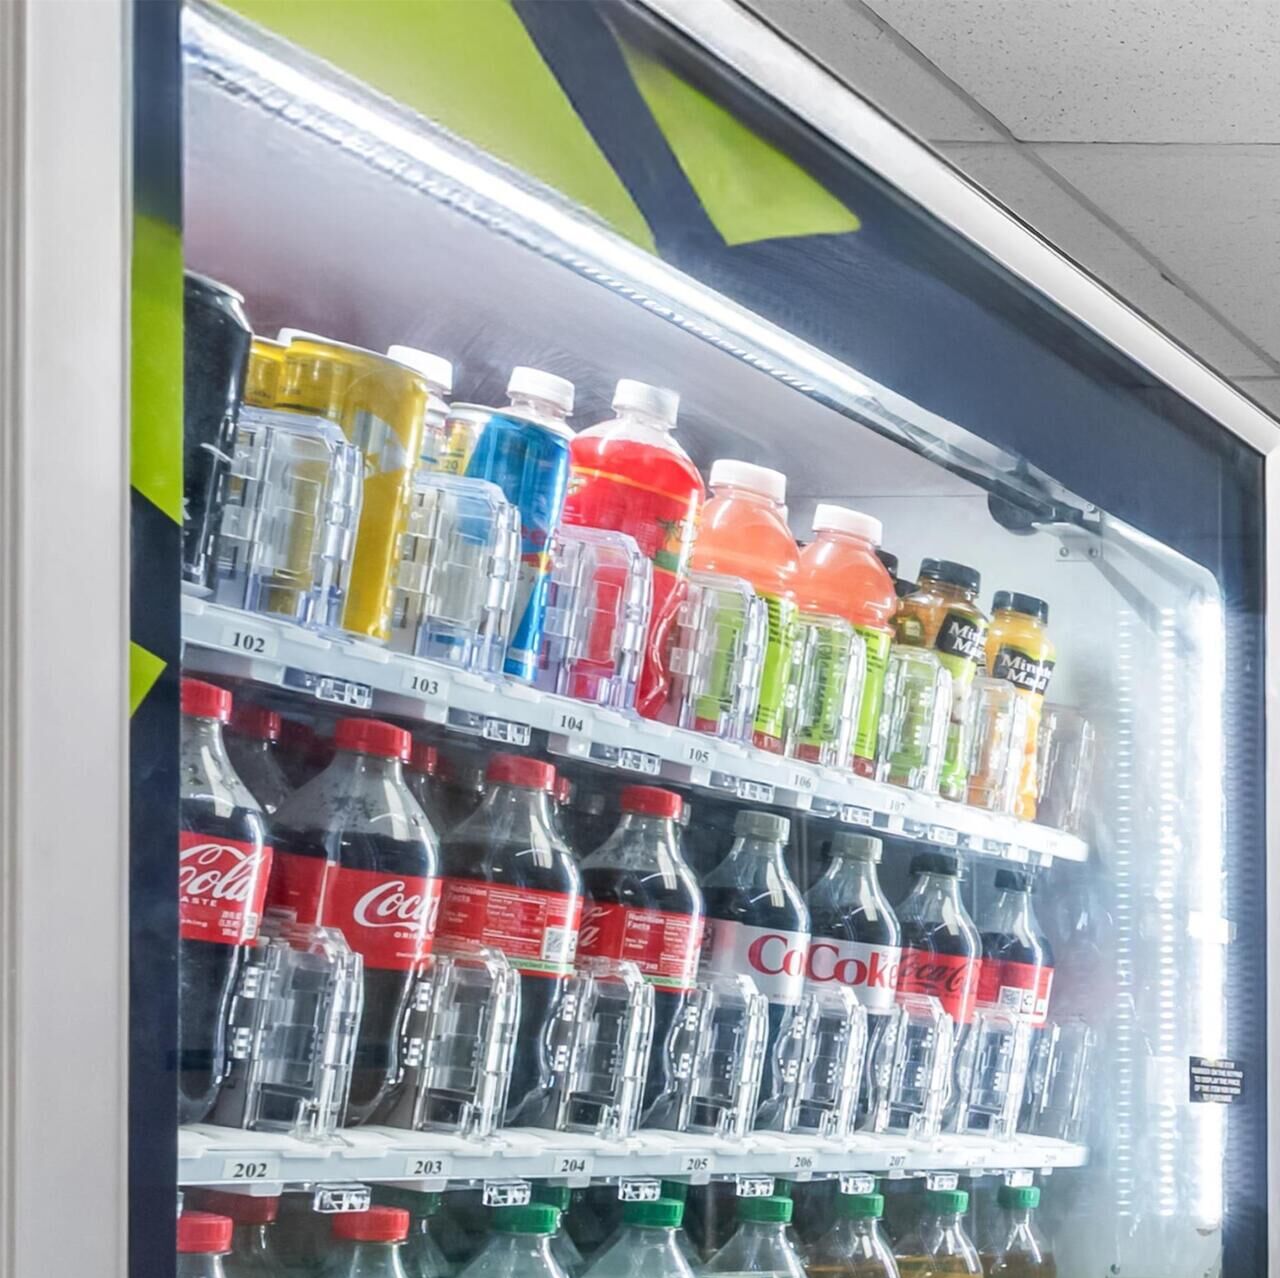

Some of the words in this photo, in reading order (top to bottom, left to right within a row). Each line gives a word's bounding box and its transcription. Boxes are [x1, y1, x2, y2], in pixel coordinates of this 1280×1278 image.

[232, 631, 265, 653] 102
[411, 675, 439, 695] 103
[560, 713, 584, 732] 104
[688, 747, 710, 764] 105
[794, 773, 812, 789] 106
[179, 842, 264, 903] ola
[180, 895, 218, 908] ASTE
[748, 933, 808, 977] Co
[413, 1160, 443, 1174] 203
[561, 1159, 586, 1173] 204
[687, 1157, 708, 1171] 205
[794, 1155, 813, 1168] 206
[889, 1155, 906, 1168] 207
[233, 1163, 267, 1178] 202
